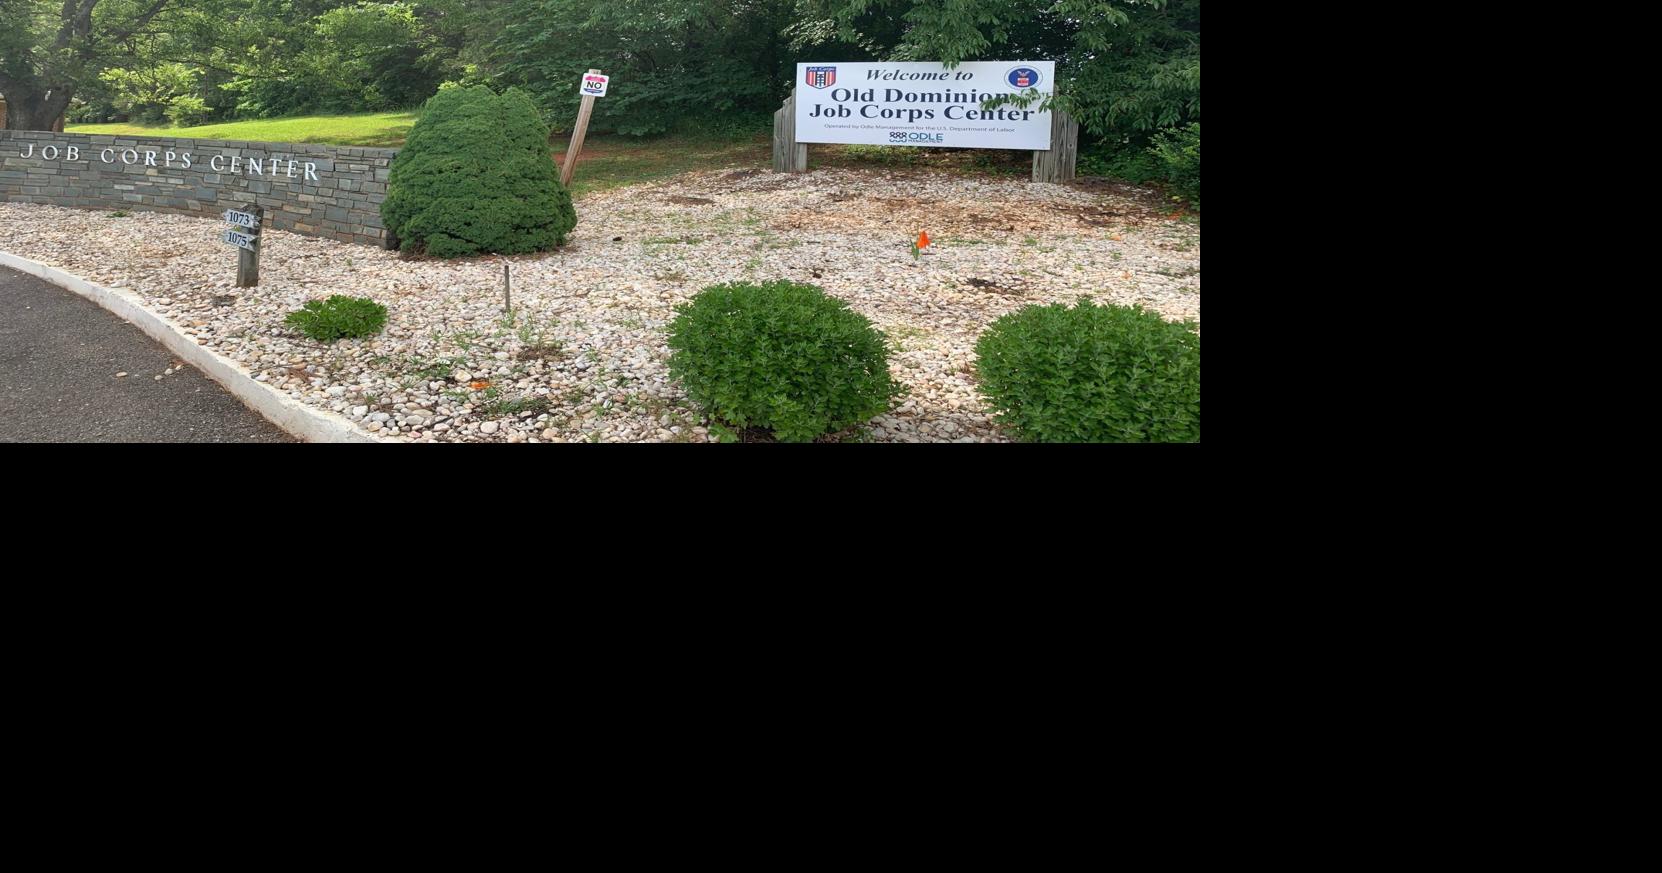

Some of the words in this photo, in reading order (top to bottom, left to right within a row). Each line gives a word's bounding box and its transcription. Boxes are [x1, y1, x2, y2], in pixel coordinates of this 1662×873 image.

[866, 69, 949, 81] Welcome
[955, 71, 974, 81] to
[587, 81, 602, 89] NO
[831, 88, 875, 102] Old
[884, 88, 1010, 104] Dominion
[809, 104, 851, 118] Job
[860, 104, 935, 123] Corps
[943, 105, 1035, 121] Center
[908, 132, 944, 141] ODLE
[20, 143, 80, 162] JOB
[101, 148, 192, 169] CORPS
[210, 154, 318, 181] CENTER
[229, 211, 250, 225] 1073
[228, 232, 247, 247] 1075
